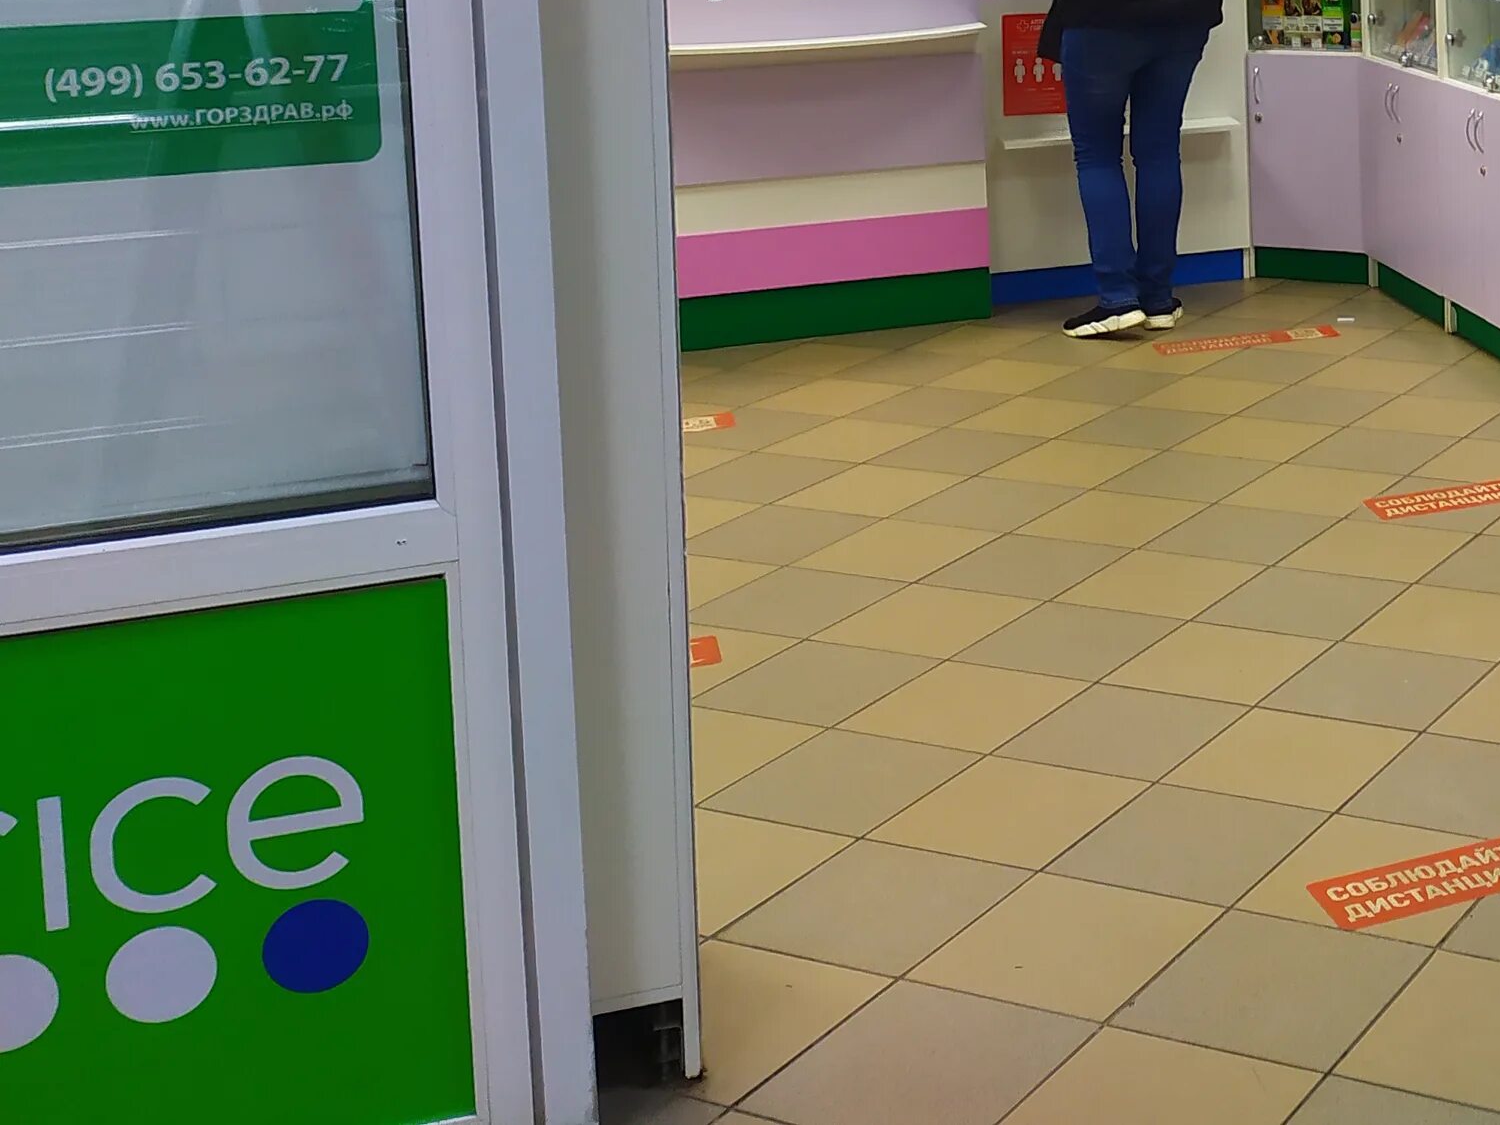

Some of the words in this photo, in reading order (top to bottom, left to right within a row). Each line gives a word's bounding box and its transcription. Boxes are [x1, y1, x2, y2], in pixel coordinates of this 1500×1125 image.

[44, 64, 144, 103] (499)
[154, 54, 350, 92] 653-62-77
[130, 100, 354, 130] www.ГОРЗДРАВ.рф
